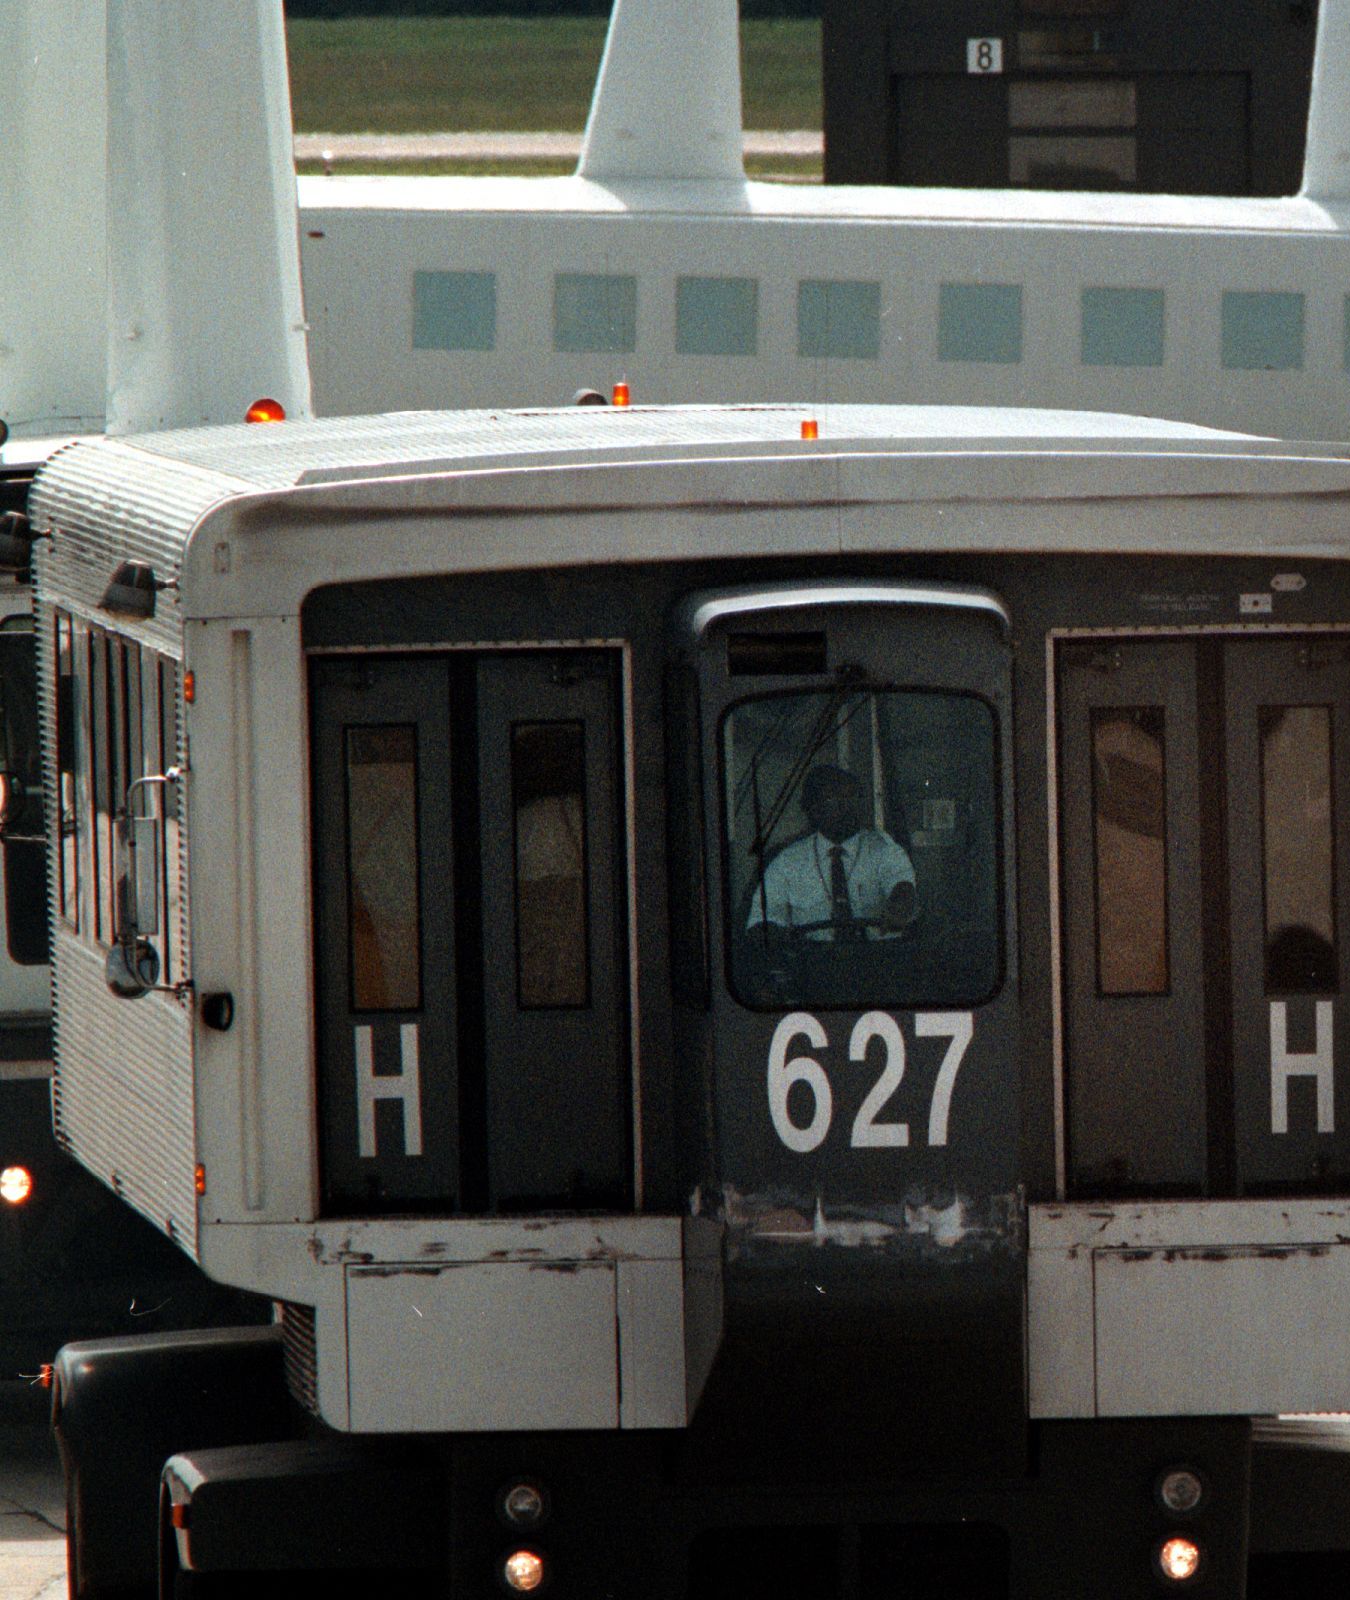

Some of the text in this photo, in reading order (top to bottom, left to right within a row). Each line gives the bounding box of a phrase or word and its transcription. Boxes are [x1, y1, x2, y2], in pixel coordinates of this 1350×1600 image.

[977, 42, 993, 70] 8
[355, 1023, 421, 1158] H
[766, 1010, 975, 1153] 627
[1270, 1000, 1335, 1134] H
